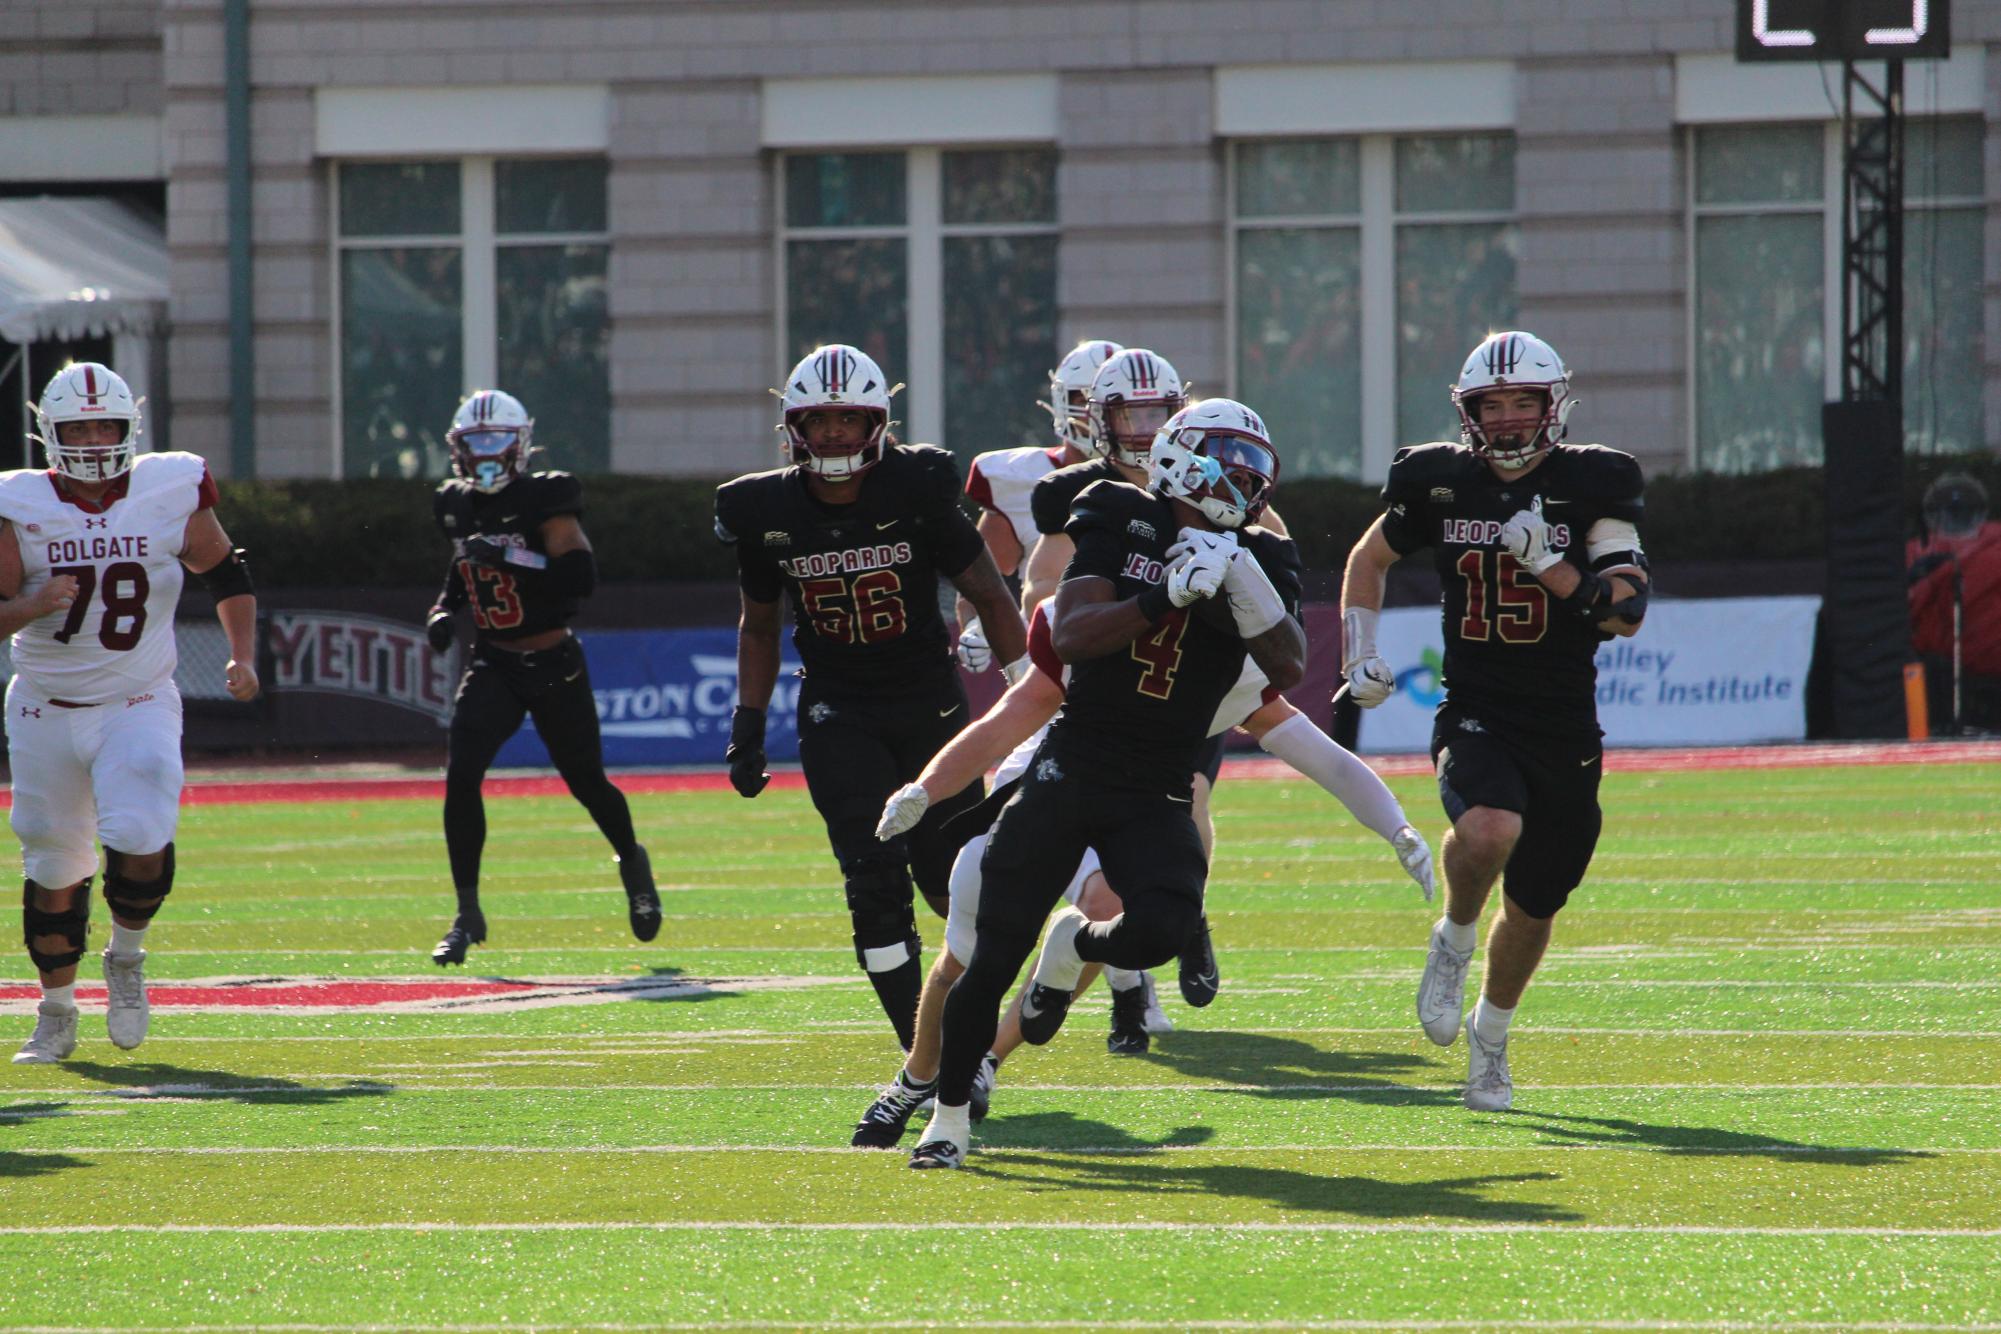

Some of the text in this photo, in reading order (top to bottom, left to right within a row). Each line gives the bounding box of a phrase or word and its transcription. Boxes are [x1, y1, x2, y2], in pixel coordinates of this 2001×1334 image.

[48, 536, 148, 564] COLGATE
[779, 542, 913, 578] LEOPARDS
[51, 562, 150, 651] 78
[457, 559, 525, 629] 13
[798, 569, 906, 644] 56
[1457, 549, 1549, 644] 15
[1131, 608, 1191, 700] 4
[1658, 675, 1793, 706] Institute
